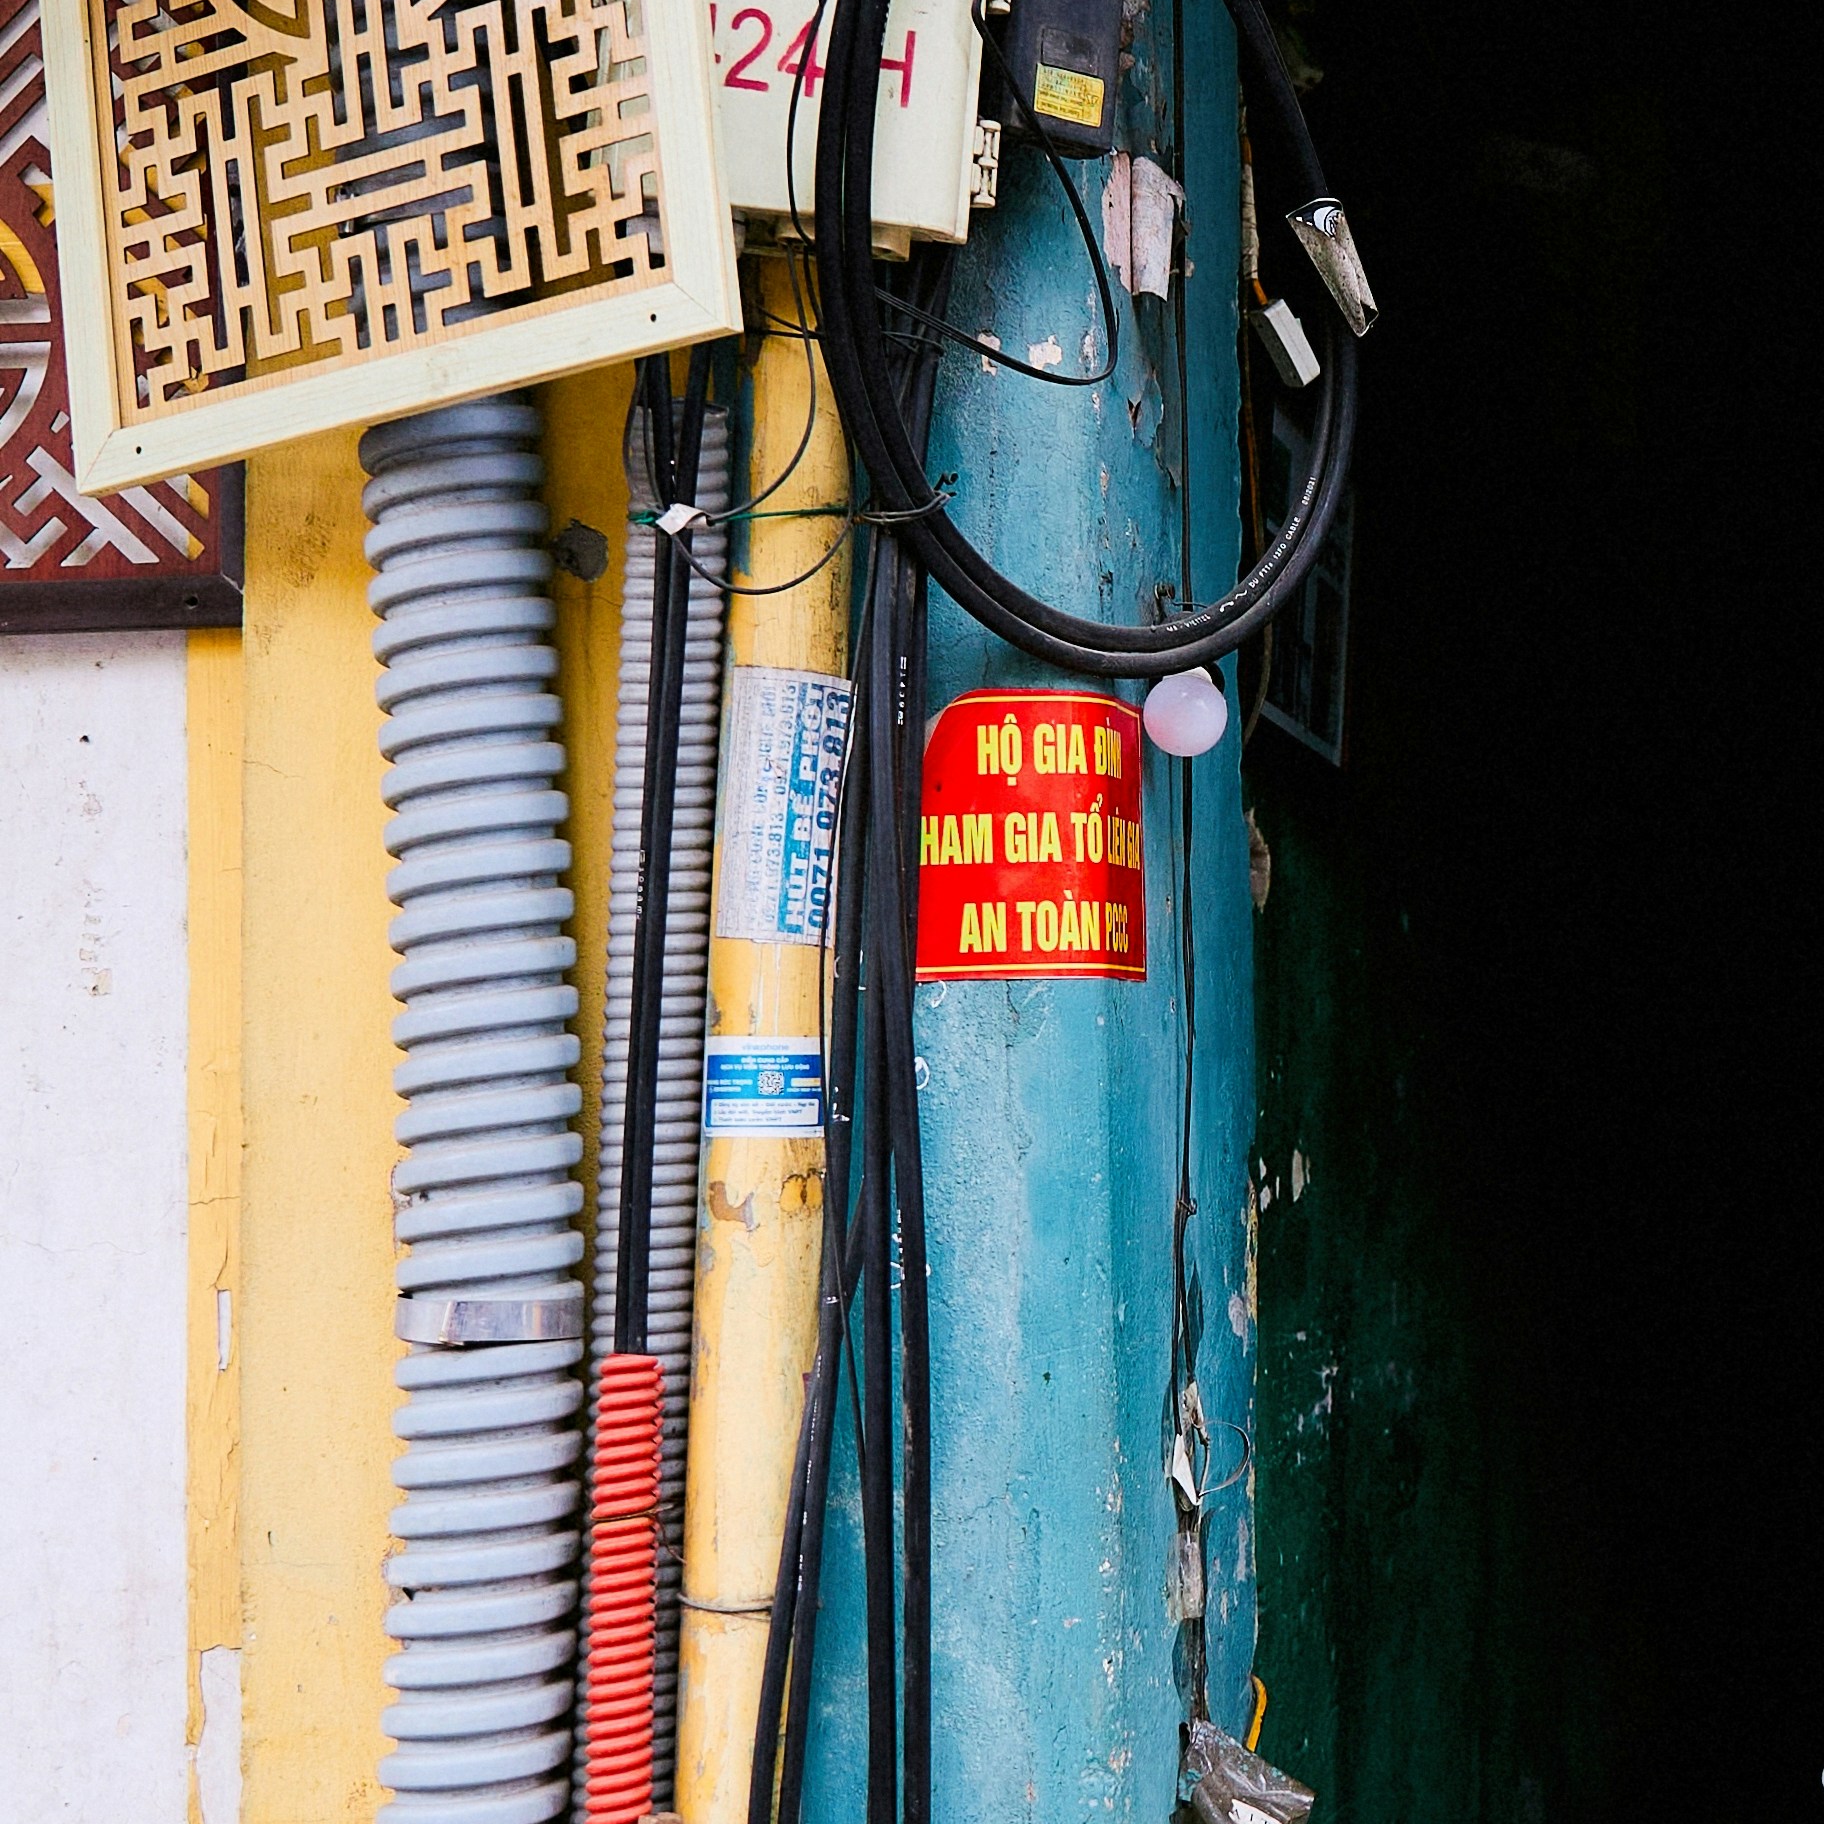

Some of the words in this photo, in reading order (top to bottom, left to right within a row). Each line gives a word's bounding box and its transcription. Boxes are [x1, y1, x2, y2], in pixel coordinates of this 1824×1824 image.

[977, 713, 1023, 787] HỘ
[1033, 723, 1088, 775] GIA
[1004, 811, 1063, 864] GIA
[1070, 792, 1104, 864] TỔ
[959, 901, 1007, 954] AN
[1015, 889, 1101, 953] TOÀN
[1105, 900, 1129, 954] PCCC
